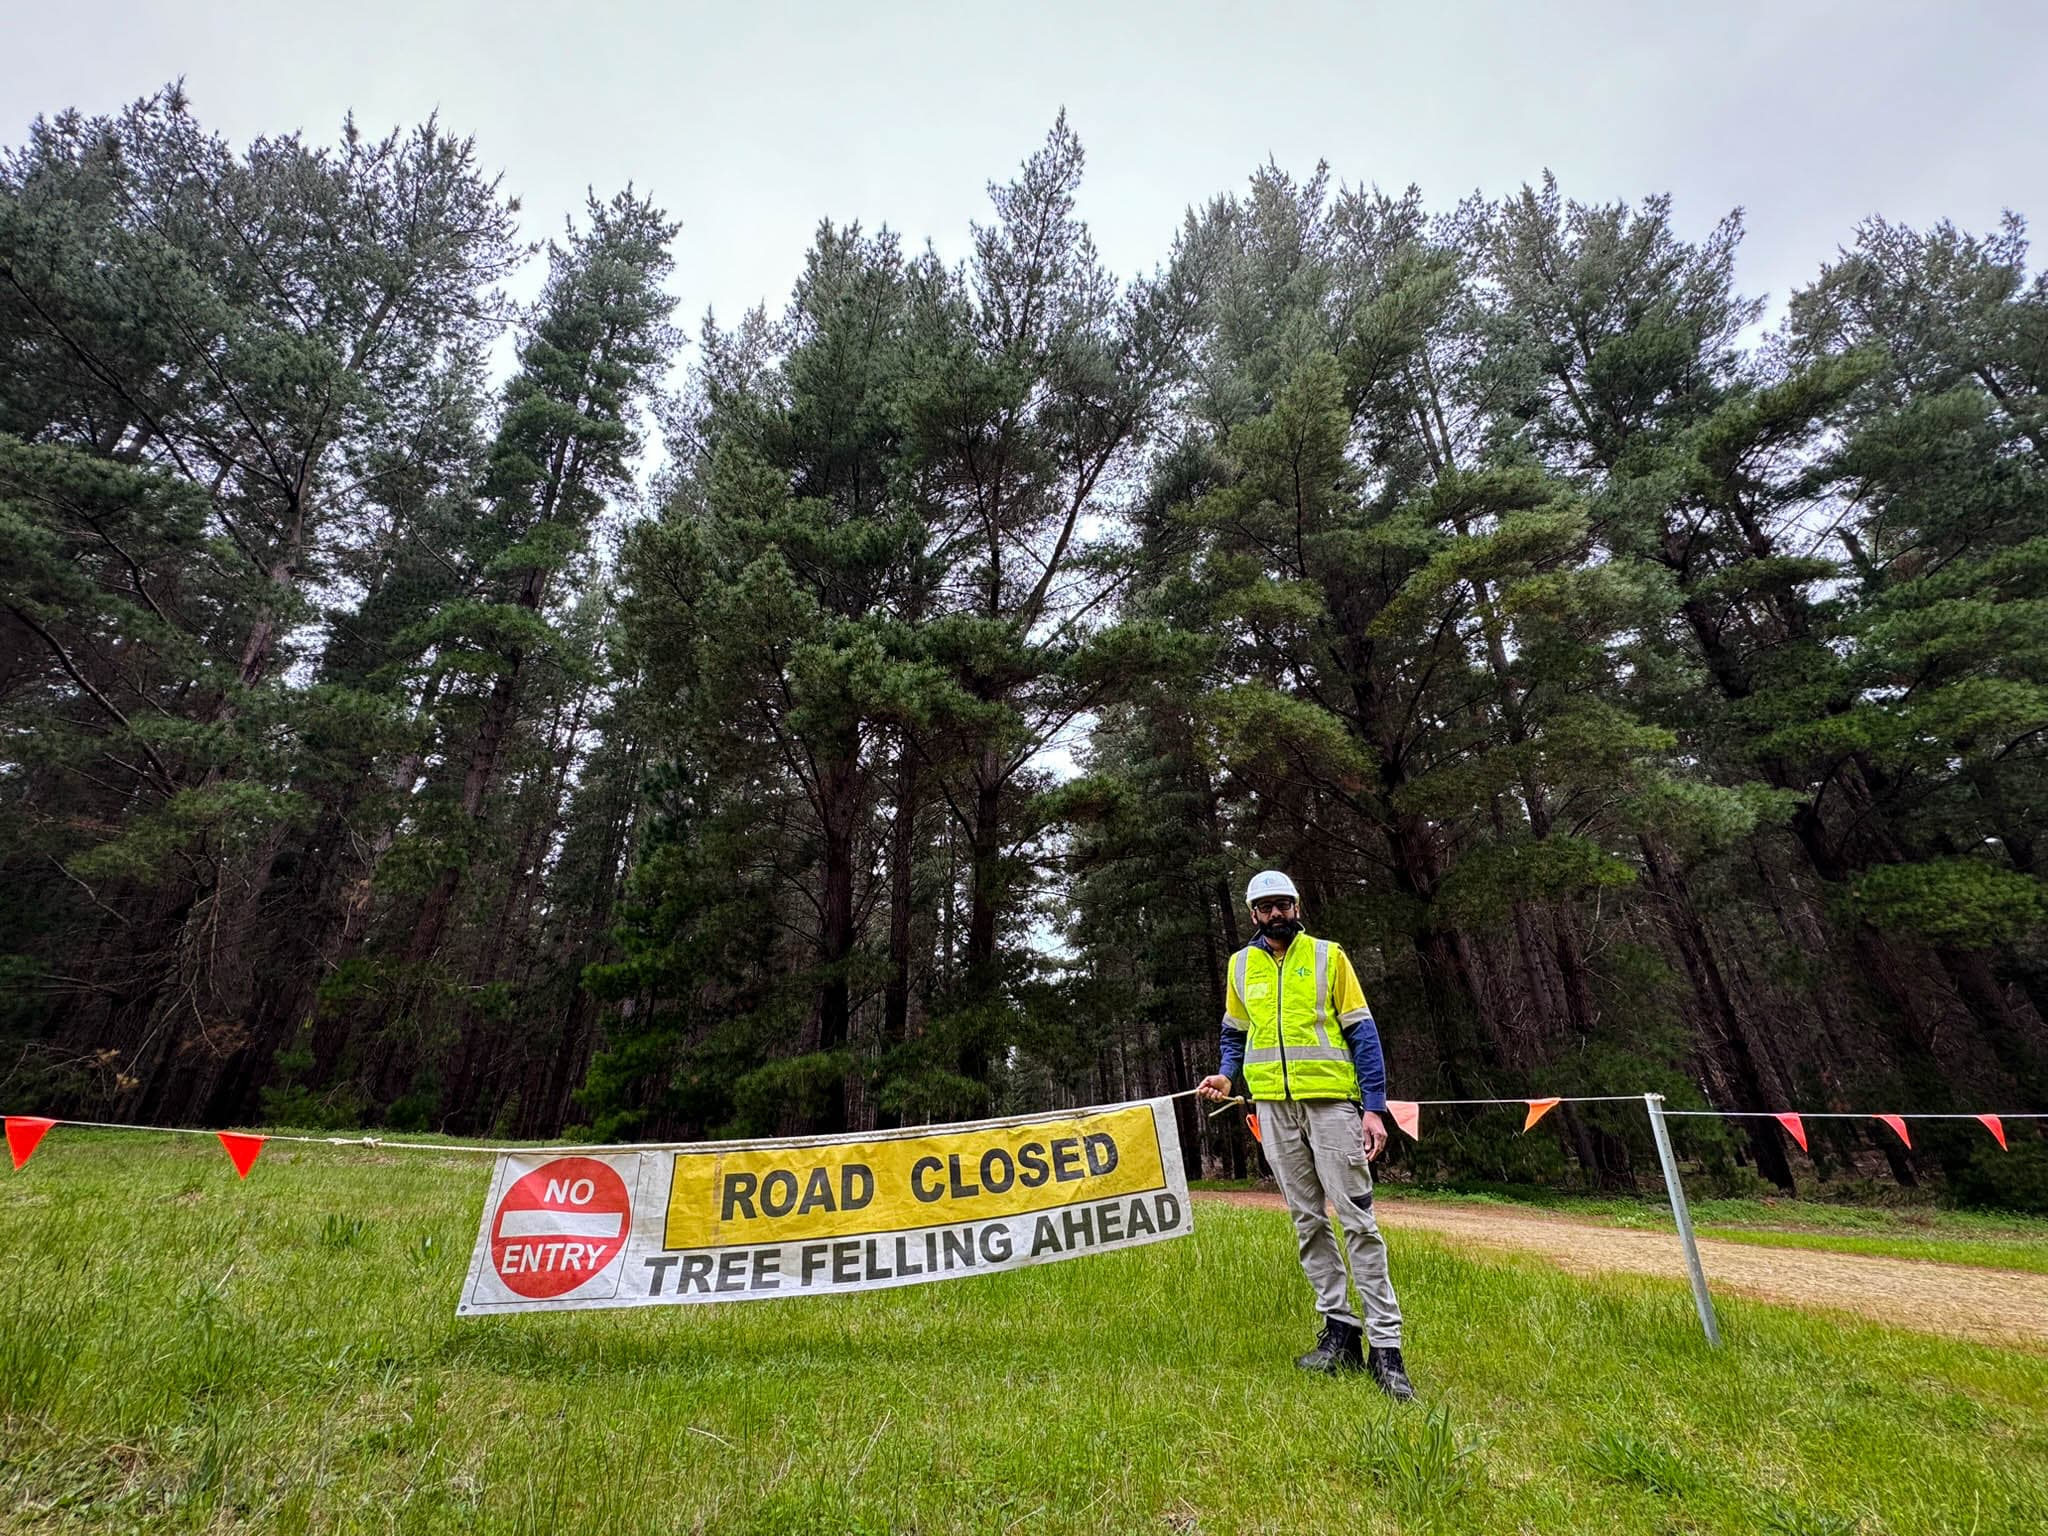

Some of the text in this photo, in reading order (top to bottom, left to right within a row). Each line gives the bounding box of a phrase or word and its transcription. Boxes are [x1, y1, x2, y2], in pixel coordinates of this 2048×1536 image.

[543, 1178, 595, 1205] NO
[720, 1132, 1119, 1221] ROAD CLOSED
[500, 1242, 608, 1274] ENTRY
[643, 1192, 1182, 1297] TREE FELLING AHEAD
